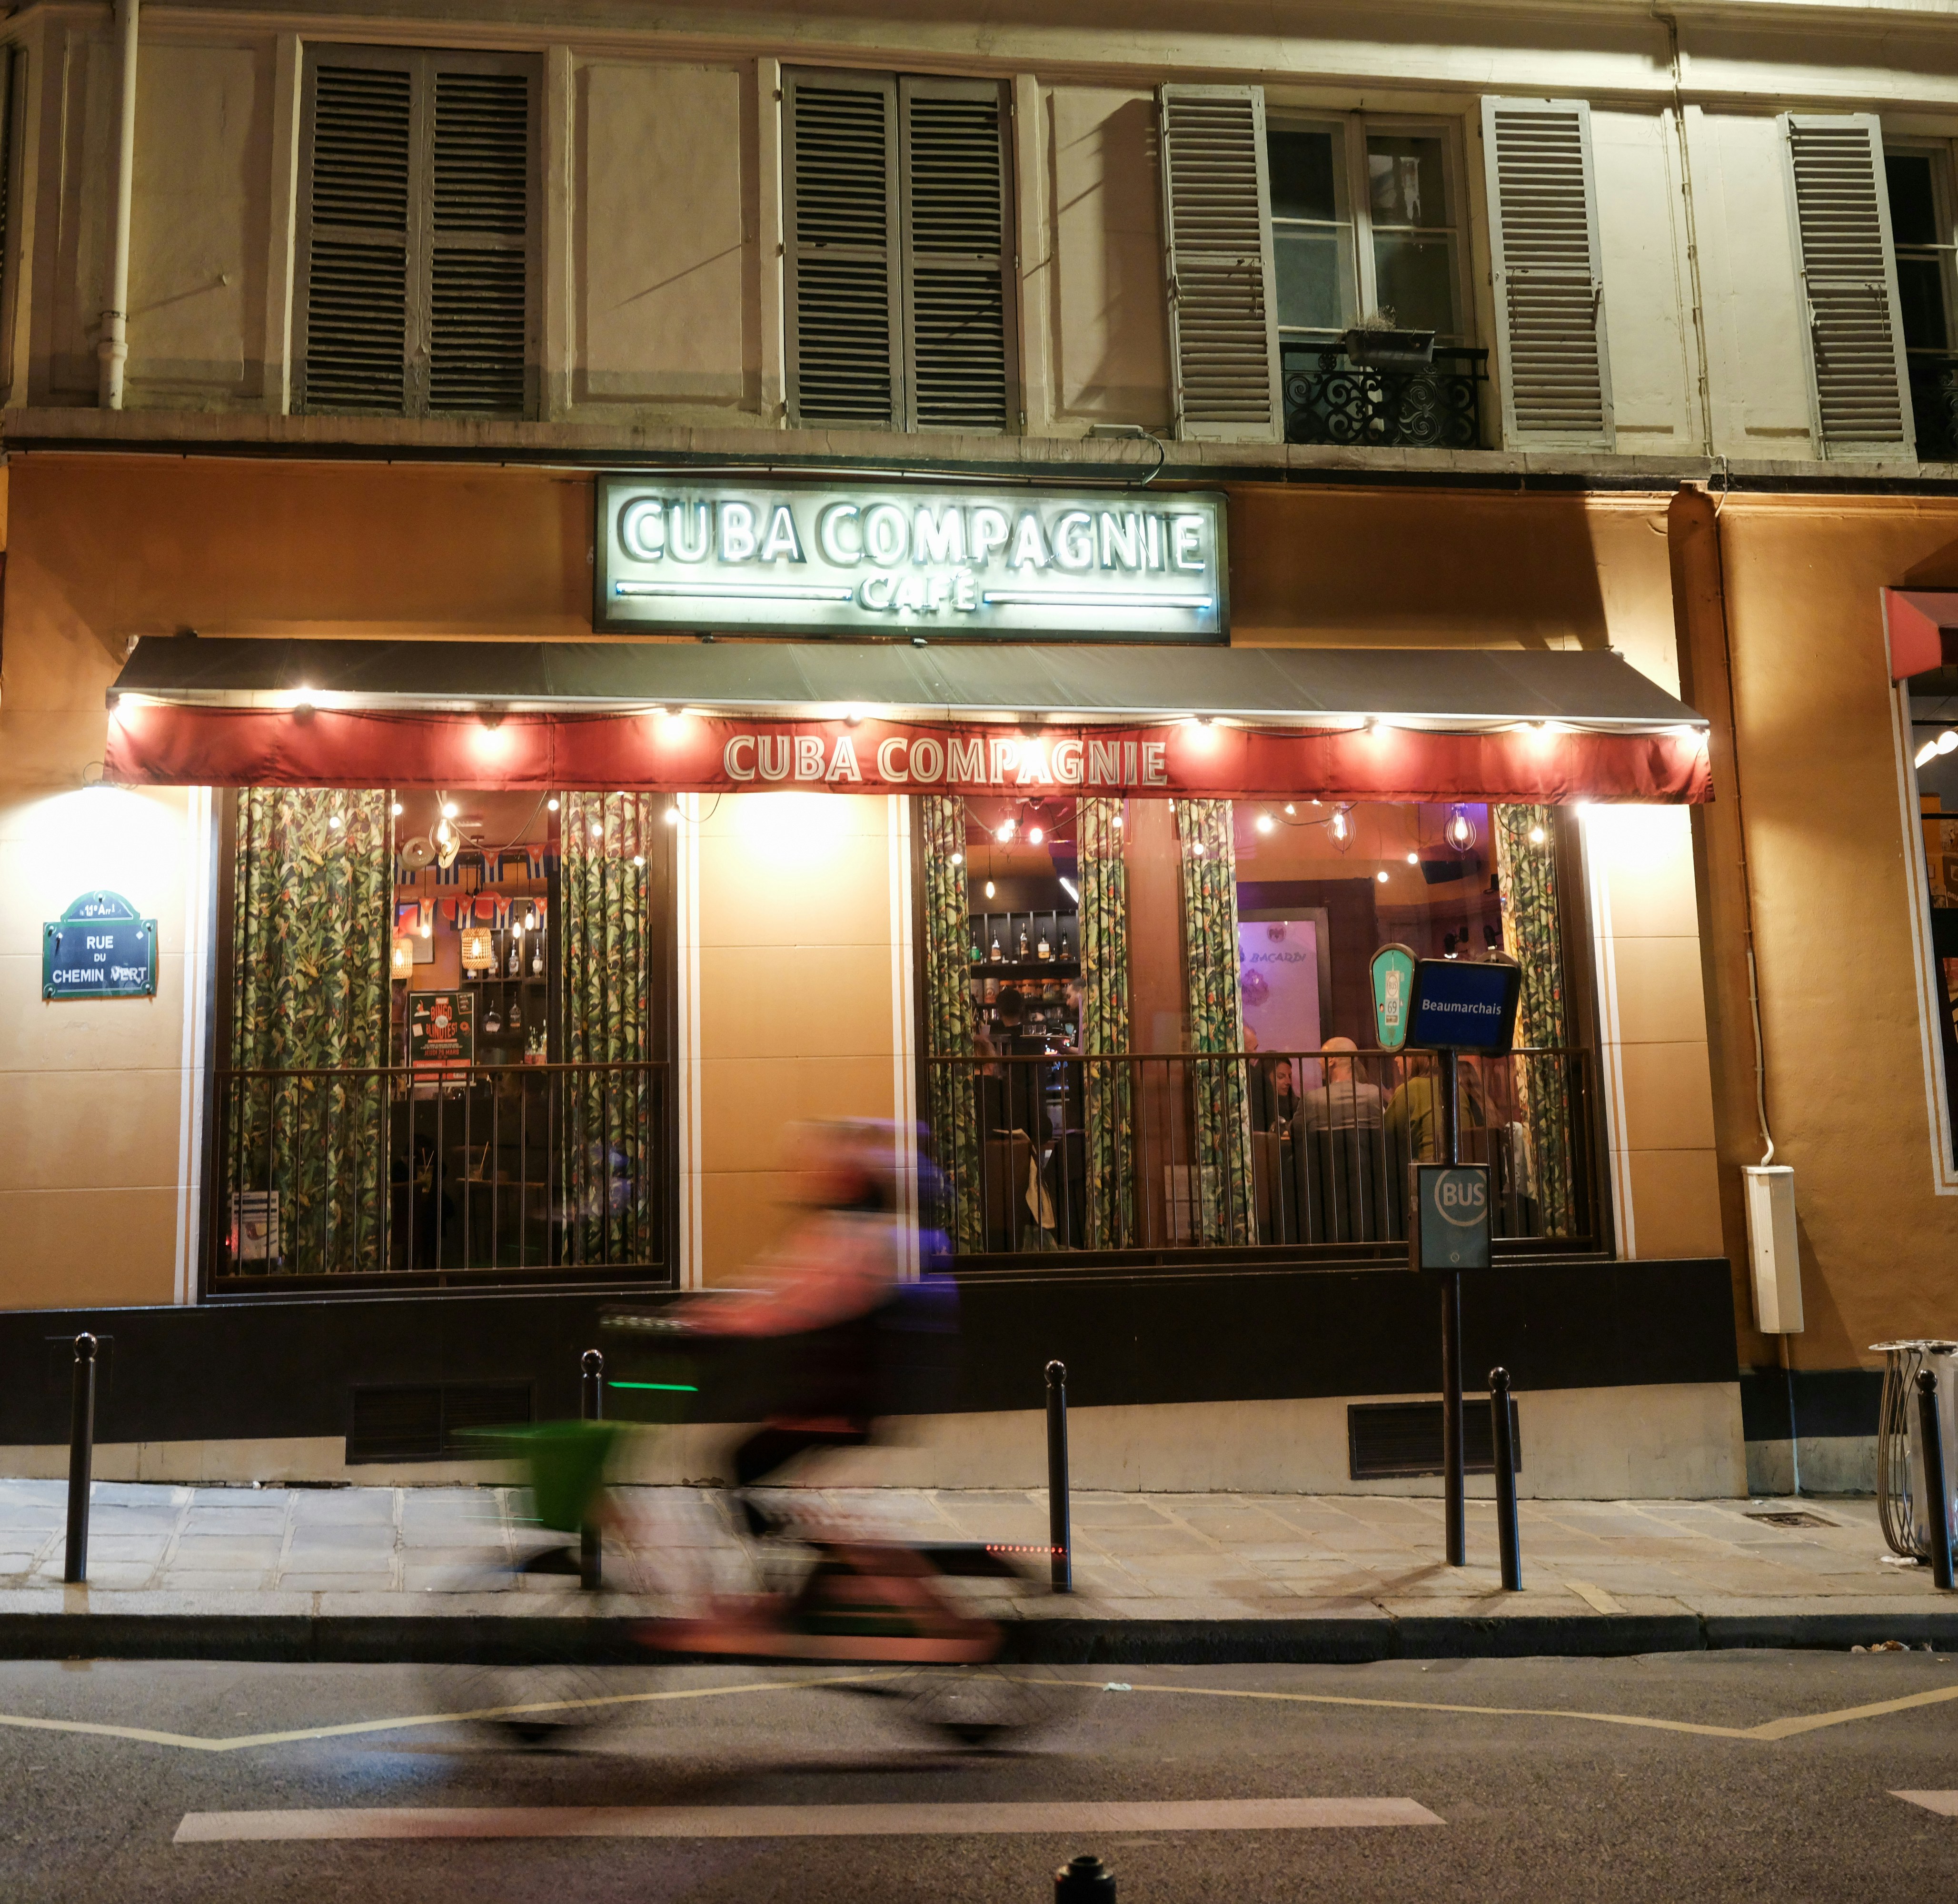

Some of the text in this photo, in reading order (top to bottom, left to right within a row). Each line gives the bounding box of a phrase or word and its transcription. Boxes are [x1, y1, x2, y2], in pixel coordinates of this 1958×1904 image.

[620, 497, 1205, 572] CUBA COMPAGNIE
[724, 735, 1167, 786] CUBA COMPAGNIE
[87, 935, 114, 949] RUE
[94, 953, 106, 962] DU
[1249, 952, 1307, 963] BACARDI
[52, 967, 147, 983] CHEMIN VERT
[1388, 981, 1397, 990] BUS
[430, 1004, 452, 1021] BINGO
[1387, 1001, 1397, 1014] 69
[1422, 999, 1501, 1015] Beaumarchais
[1443, 1182, 1485, 1206] BUS
